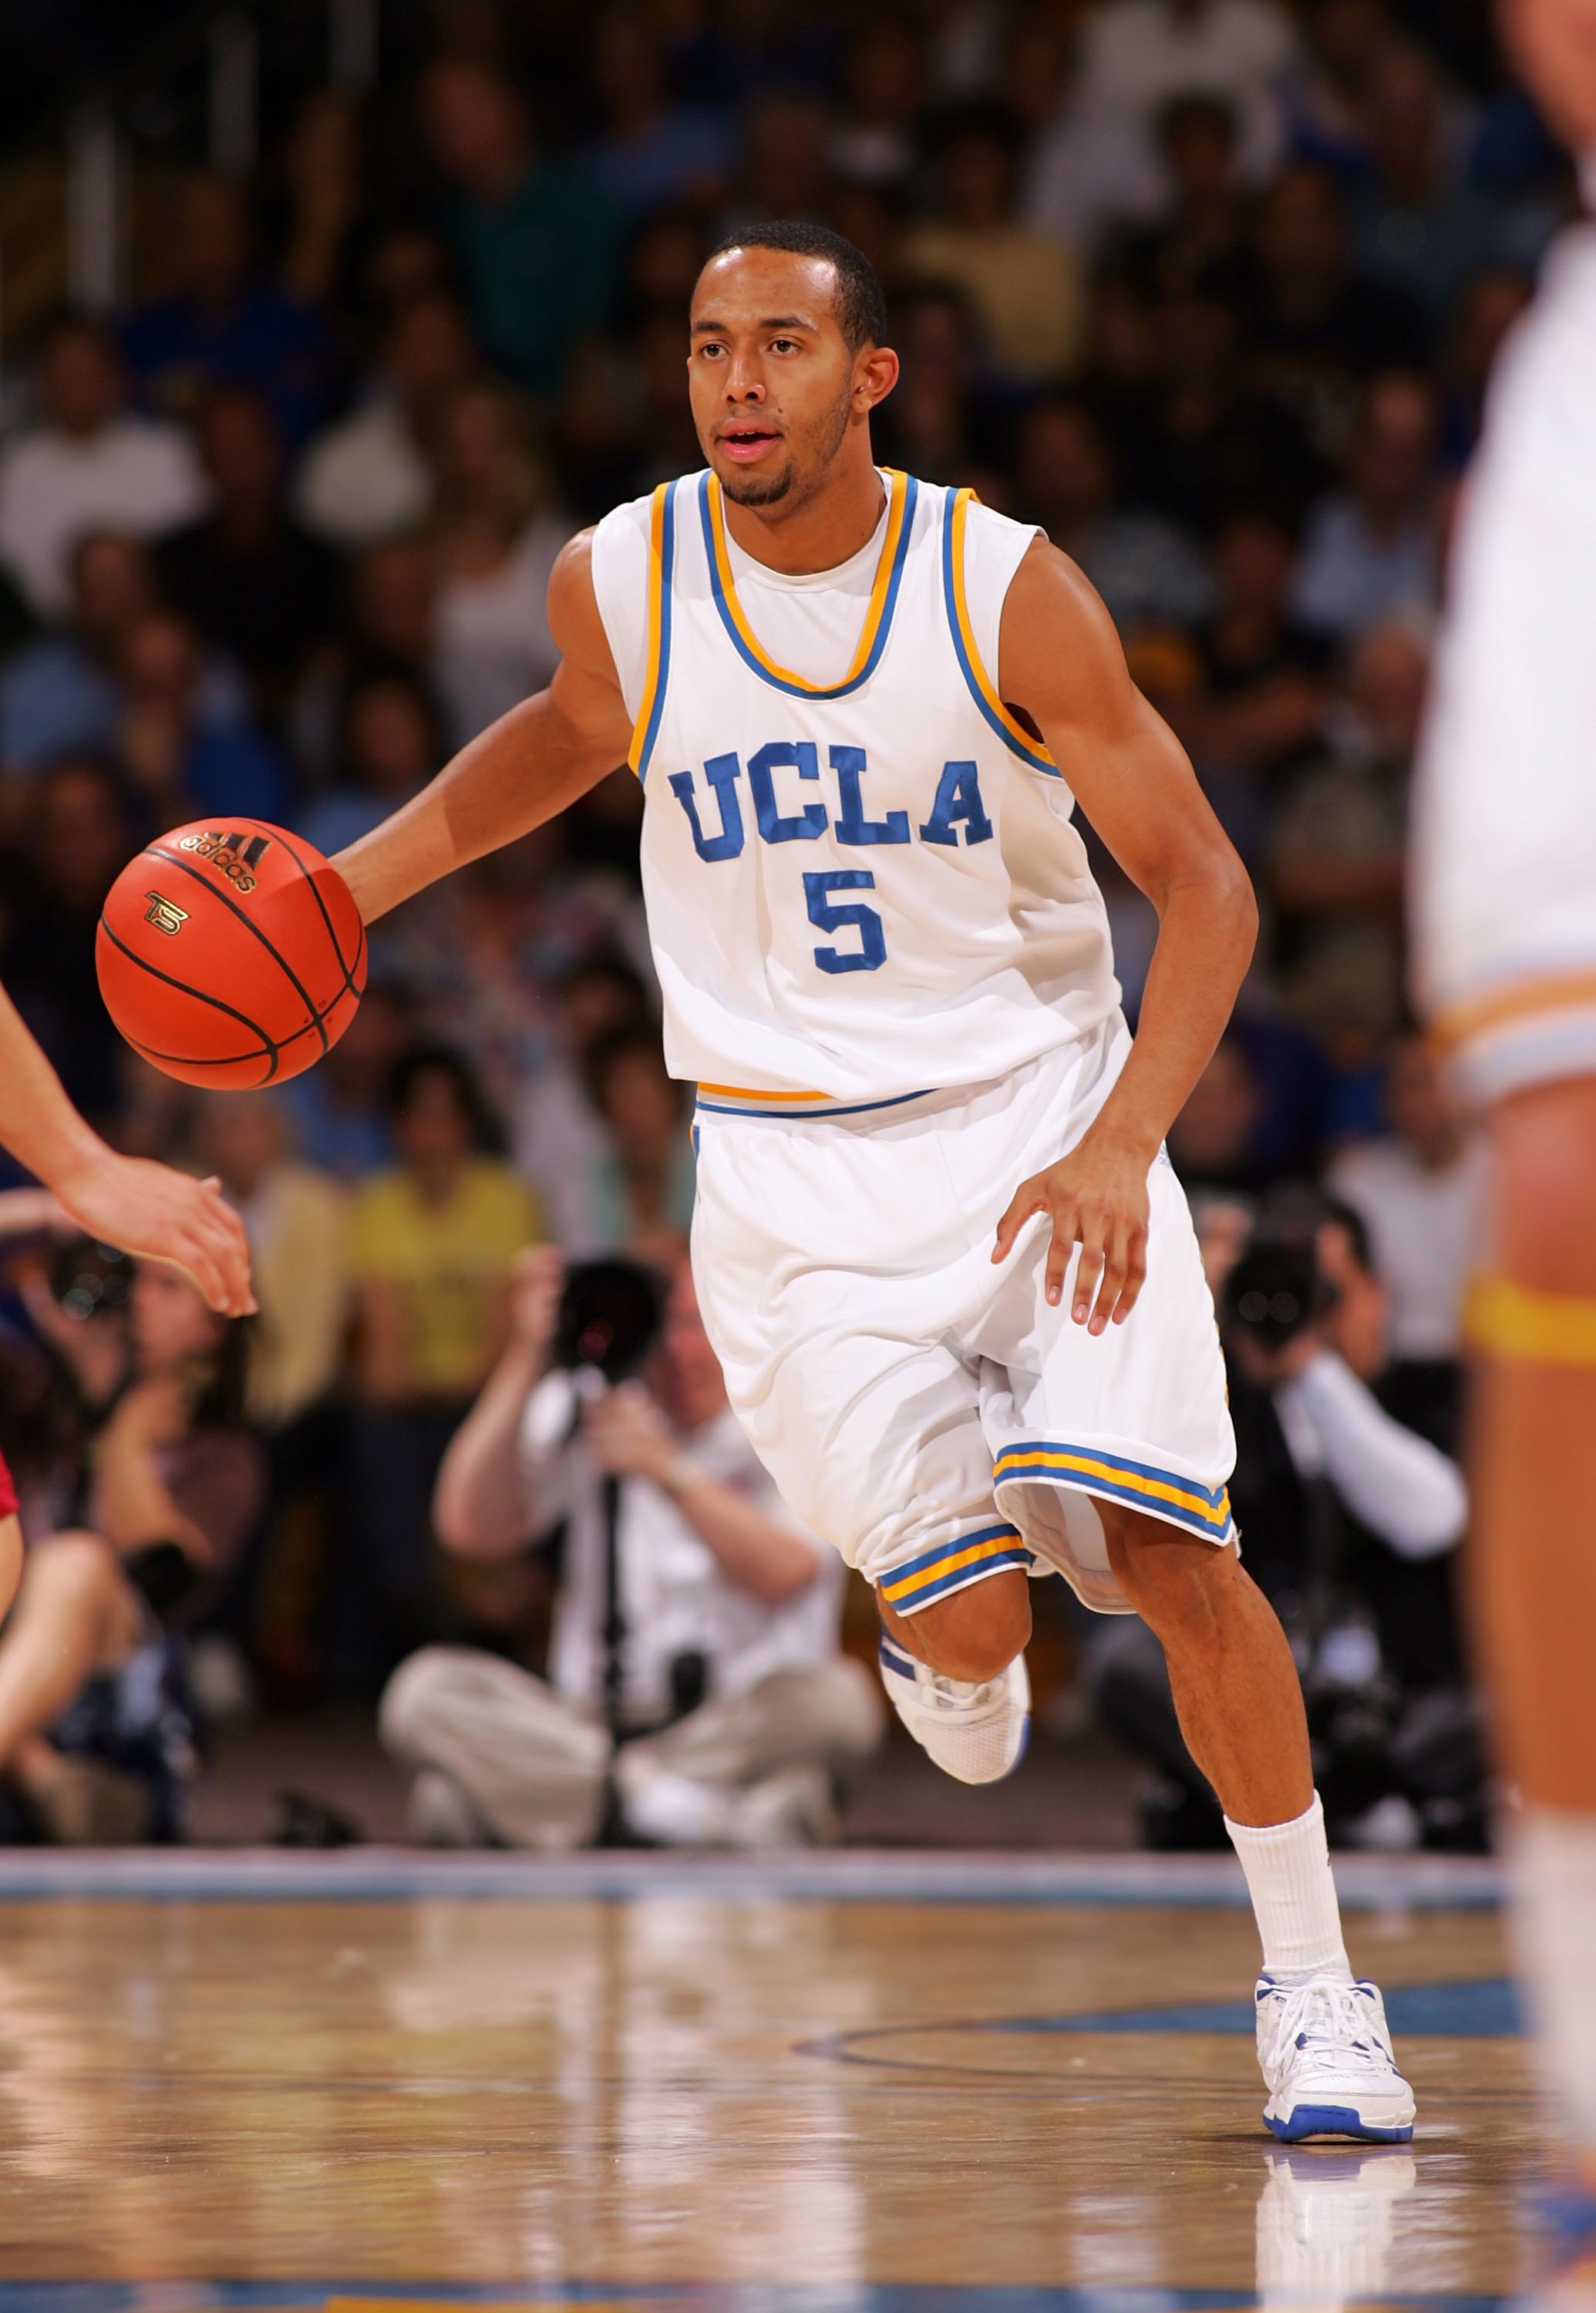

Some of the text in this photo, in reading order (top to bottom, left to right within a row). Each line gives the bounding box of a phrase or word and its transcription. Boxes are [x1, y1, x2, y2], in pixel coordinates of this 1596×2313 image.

[668, 742, 993, 863] UCLA
[179, 832, 256, 894] adidas
[803, 870, 887, 975] 5
